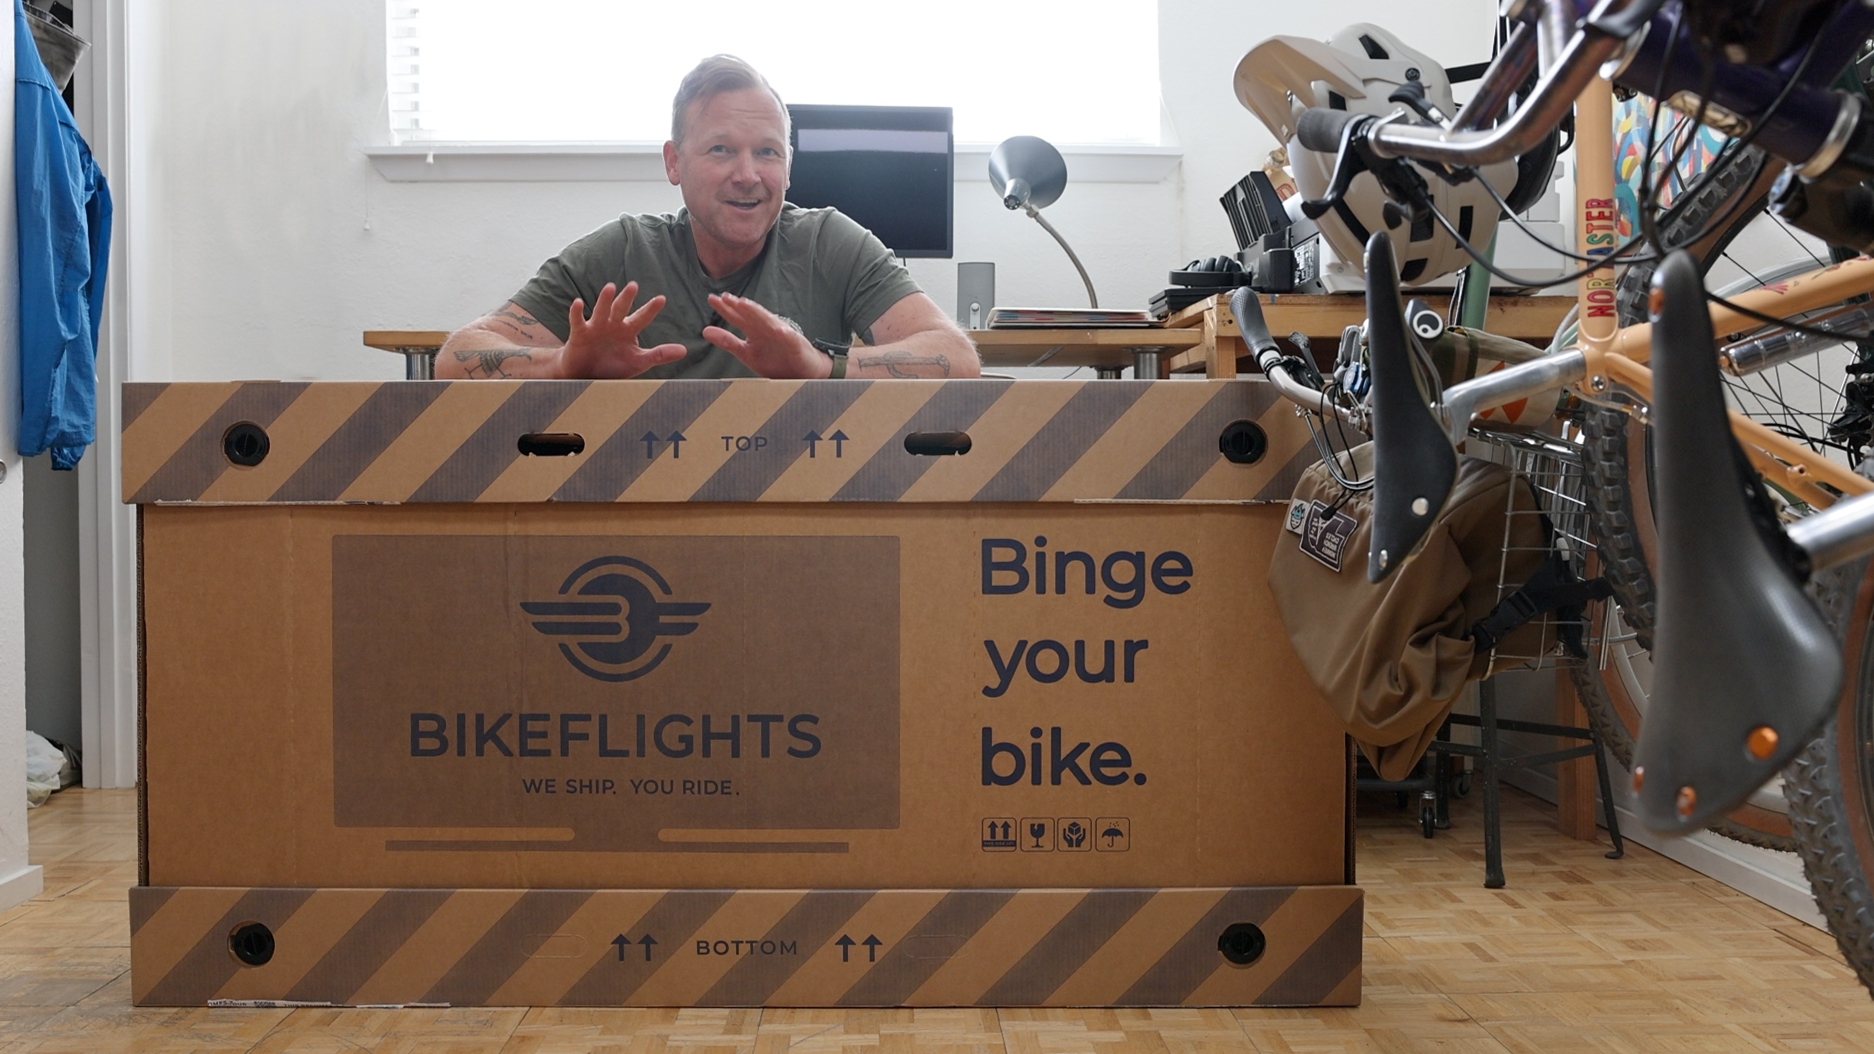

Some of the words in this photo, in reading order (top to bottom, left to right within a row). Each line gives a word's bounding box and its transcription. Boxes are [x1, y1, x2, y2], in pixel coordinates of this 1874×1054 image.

[721, 435, 768, 452] TOP
[981, 535, 1194, 609] Binge
[982, 639, 1149, 698] your
[410, 713, 822, 759] BIKEFLIGHTS
[981, 726, 1147, 786] bike.
[522, 778, 557, 794] WE
[565, 778, 616, 795] SHIP.
[630, 779, 674, 796] YOU
[682, 779, 740, 796] RIDE.
[696, 940, 797, 956] BOTTOM
